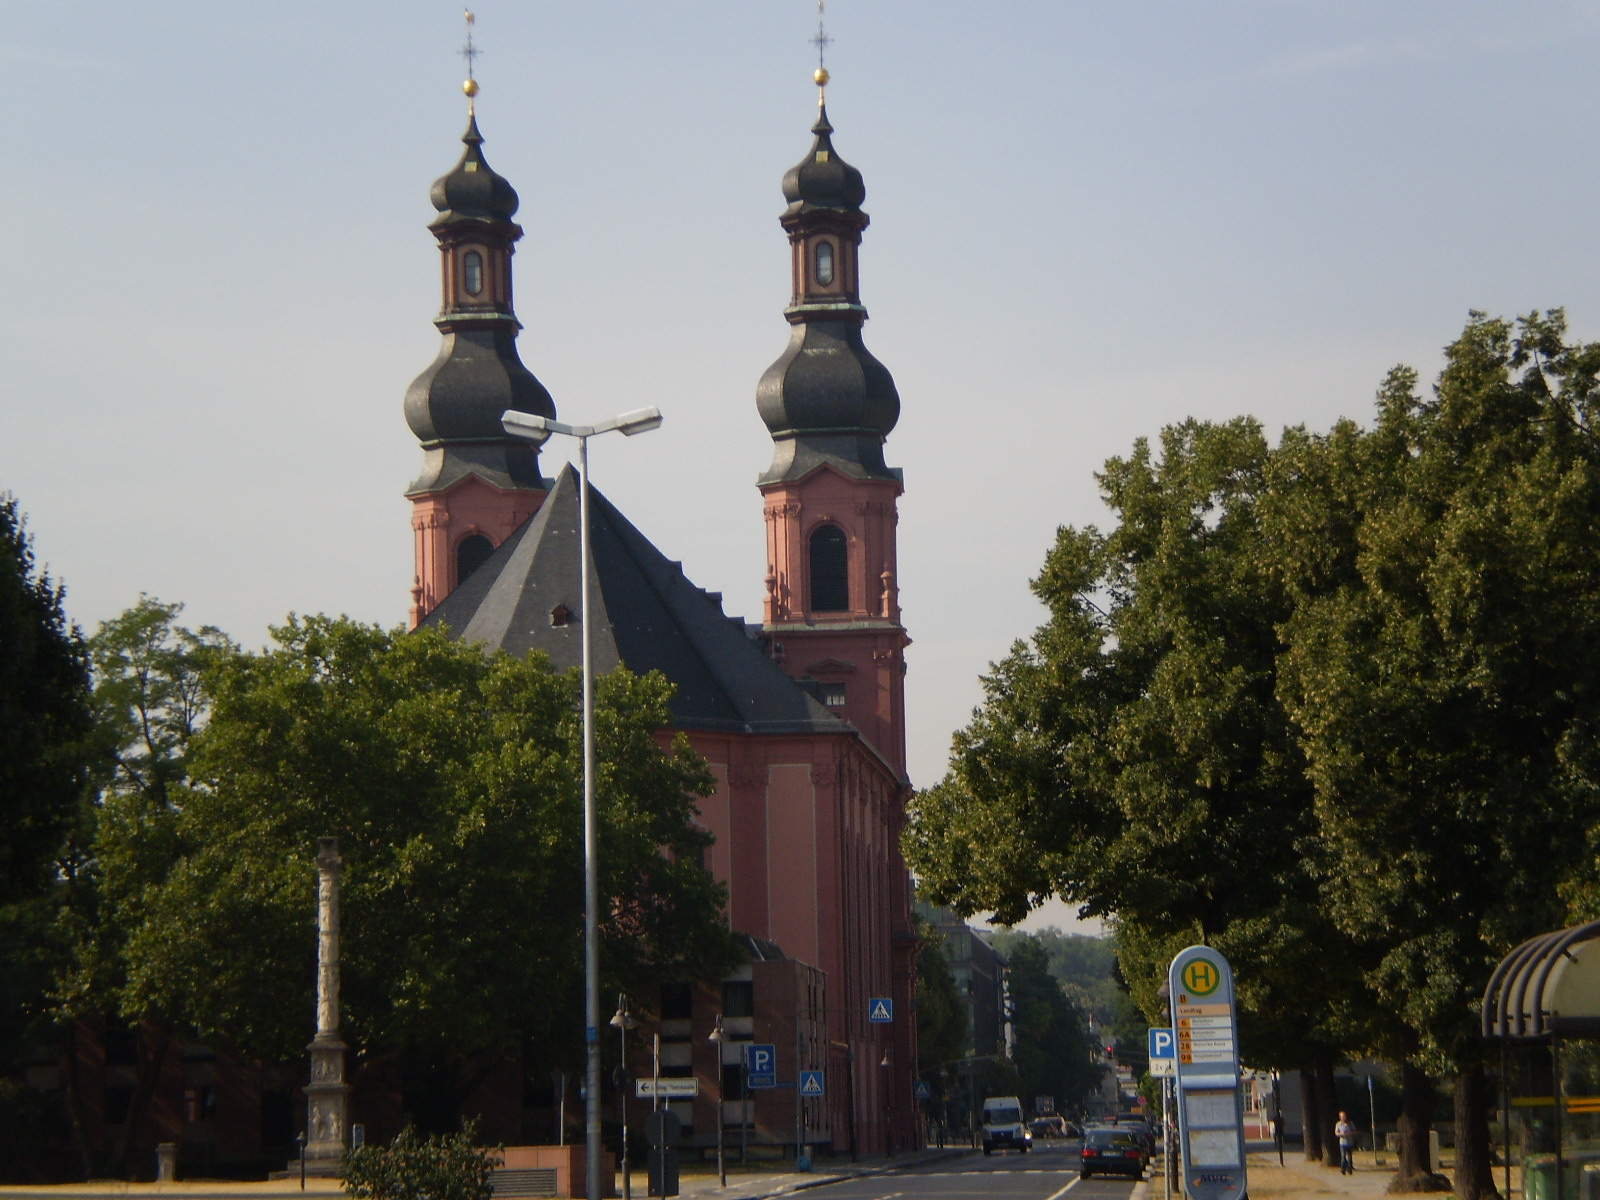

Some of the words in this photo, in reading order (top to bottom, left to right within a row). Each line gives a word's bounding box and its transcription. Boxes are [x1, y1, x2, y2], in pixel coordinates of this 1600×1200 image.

[1191, 965, 1209, 988] H
[1180, 994, 1186, 1003] B
[1155, 1032, 1171, 1056] P
[1181, 1042, 1190, 1050] 28
[755, 1050, 769, 1071] P
